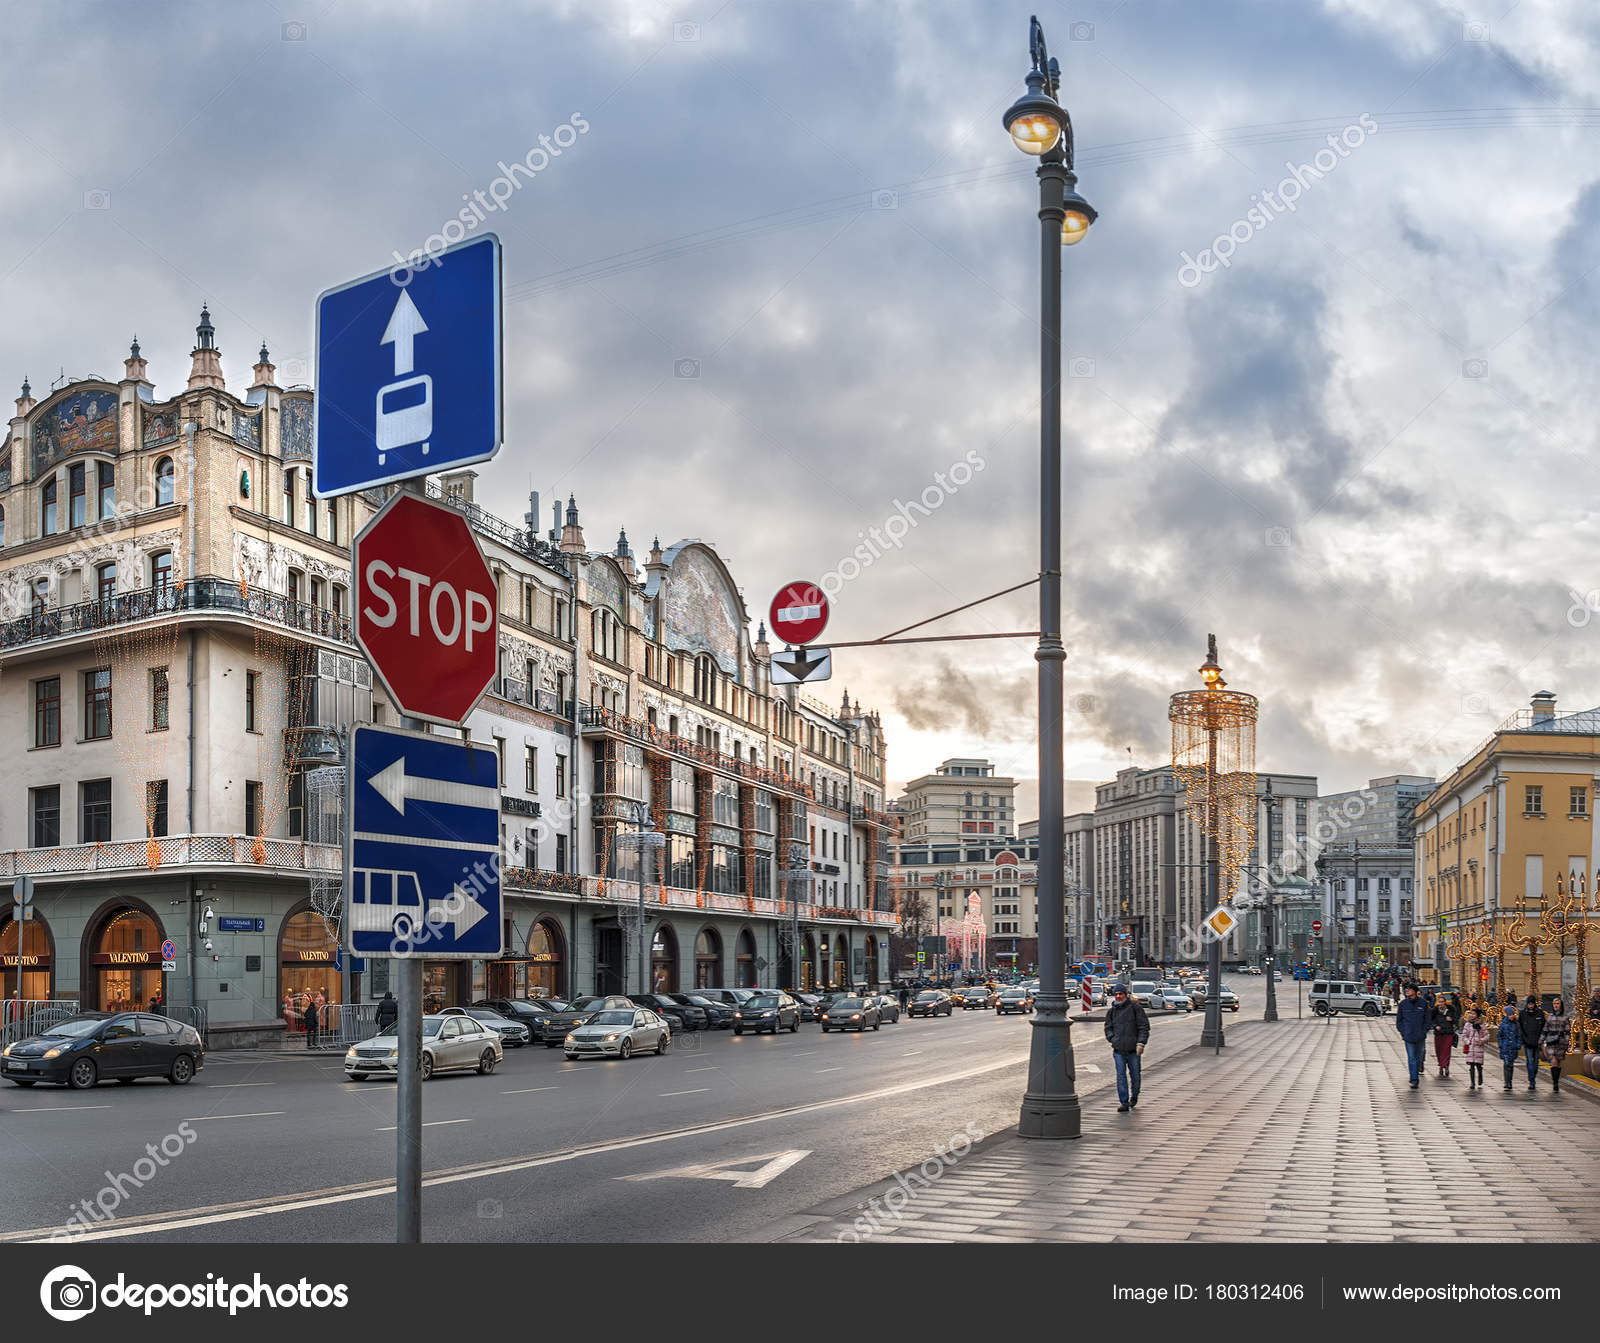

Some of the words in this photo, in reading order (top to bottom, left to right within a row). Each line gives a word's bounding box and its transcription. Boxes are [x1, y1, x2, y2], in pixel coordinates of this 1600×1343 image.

[364, 559, 493, 653] STOP
[258, 920, 263, 929] 2
[109, 952, 149, 963] VALENTINO
[300, 951, 329, 960] VALENTINO
